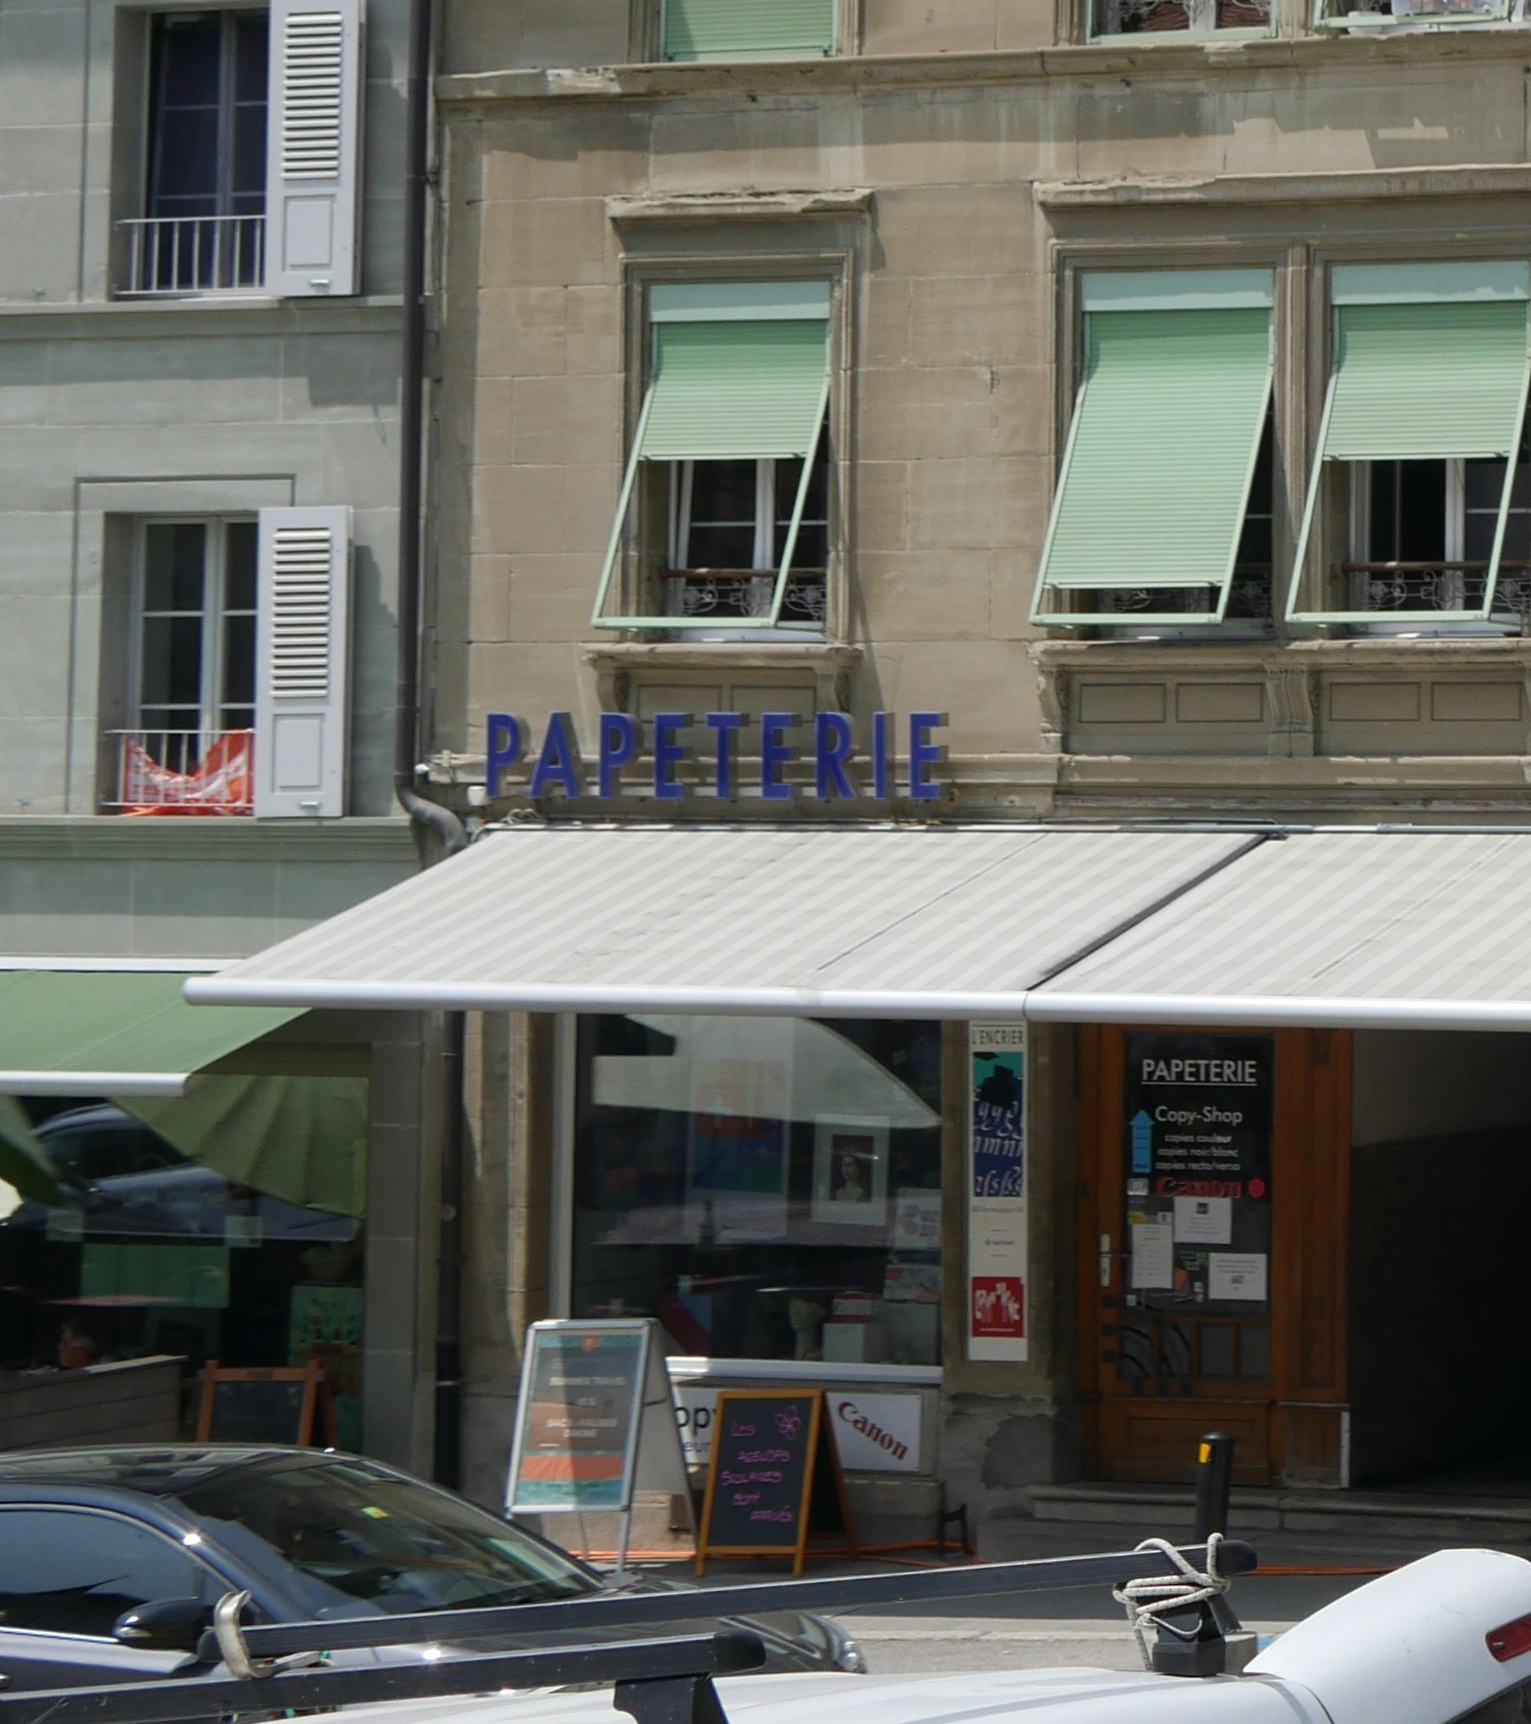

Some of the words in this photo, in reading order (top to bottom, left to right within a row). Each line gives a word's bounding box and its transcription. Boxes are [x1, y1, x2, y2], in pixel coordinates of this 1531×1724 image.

[486, 710, 949, 801] PAPETERIE
[1142, 1059, 1257, 1083] PAPETERIE
[1155, 1105, 1243, 1127] Copy-Shop
[1164, 1132, 1194, 1144] copies
[1196, 1133, 1232, 1143] couleur
[1157, 1146, 1188, 1157] copies
[1155, 1160, 1186, 1172] copies
[1155, 1174, 1242, 1198] Canon
[838, 1401, 909, 1462] Canon
